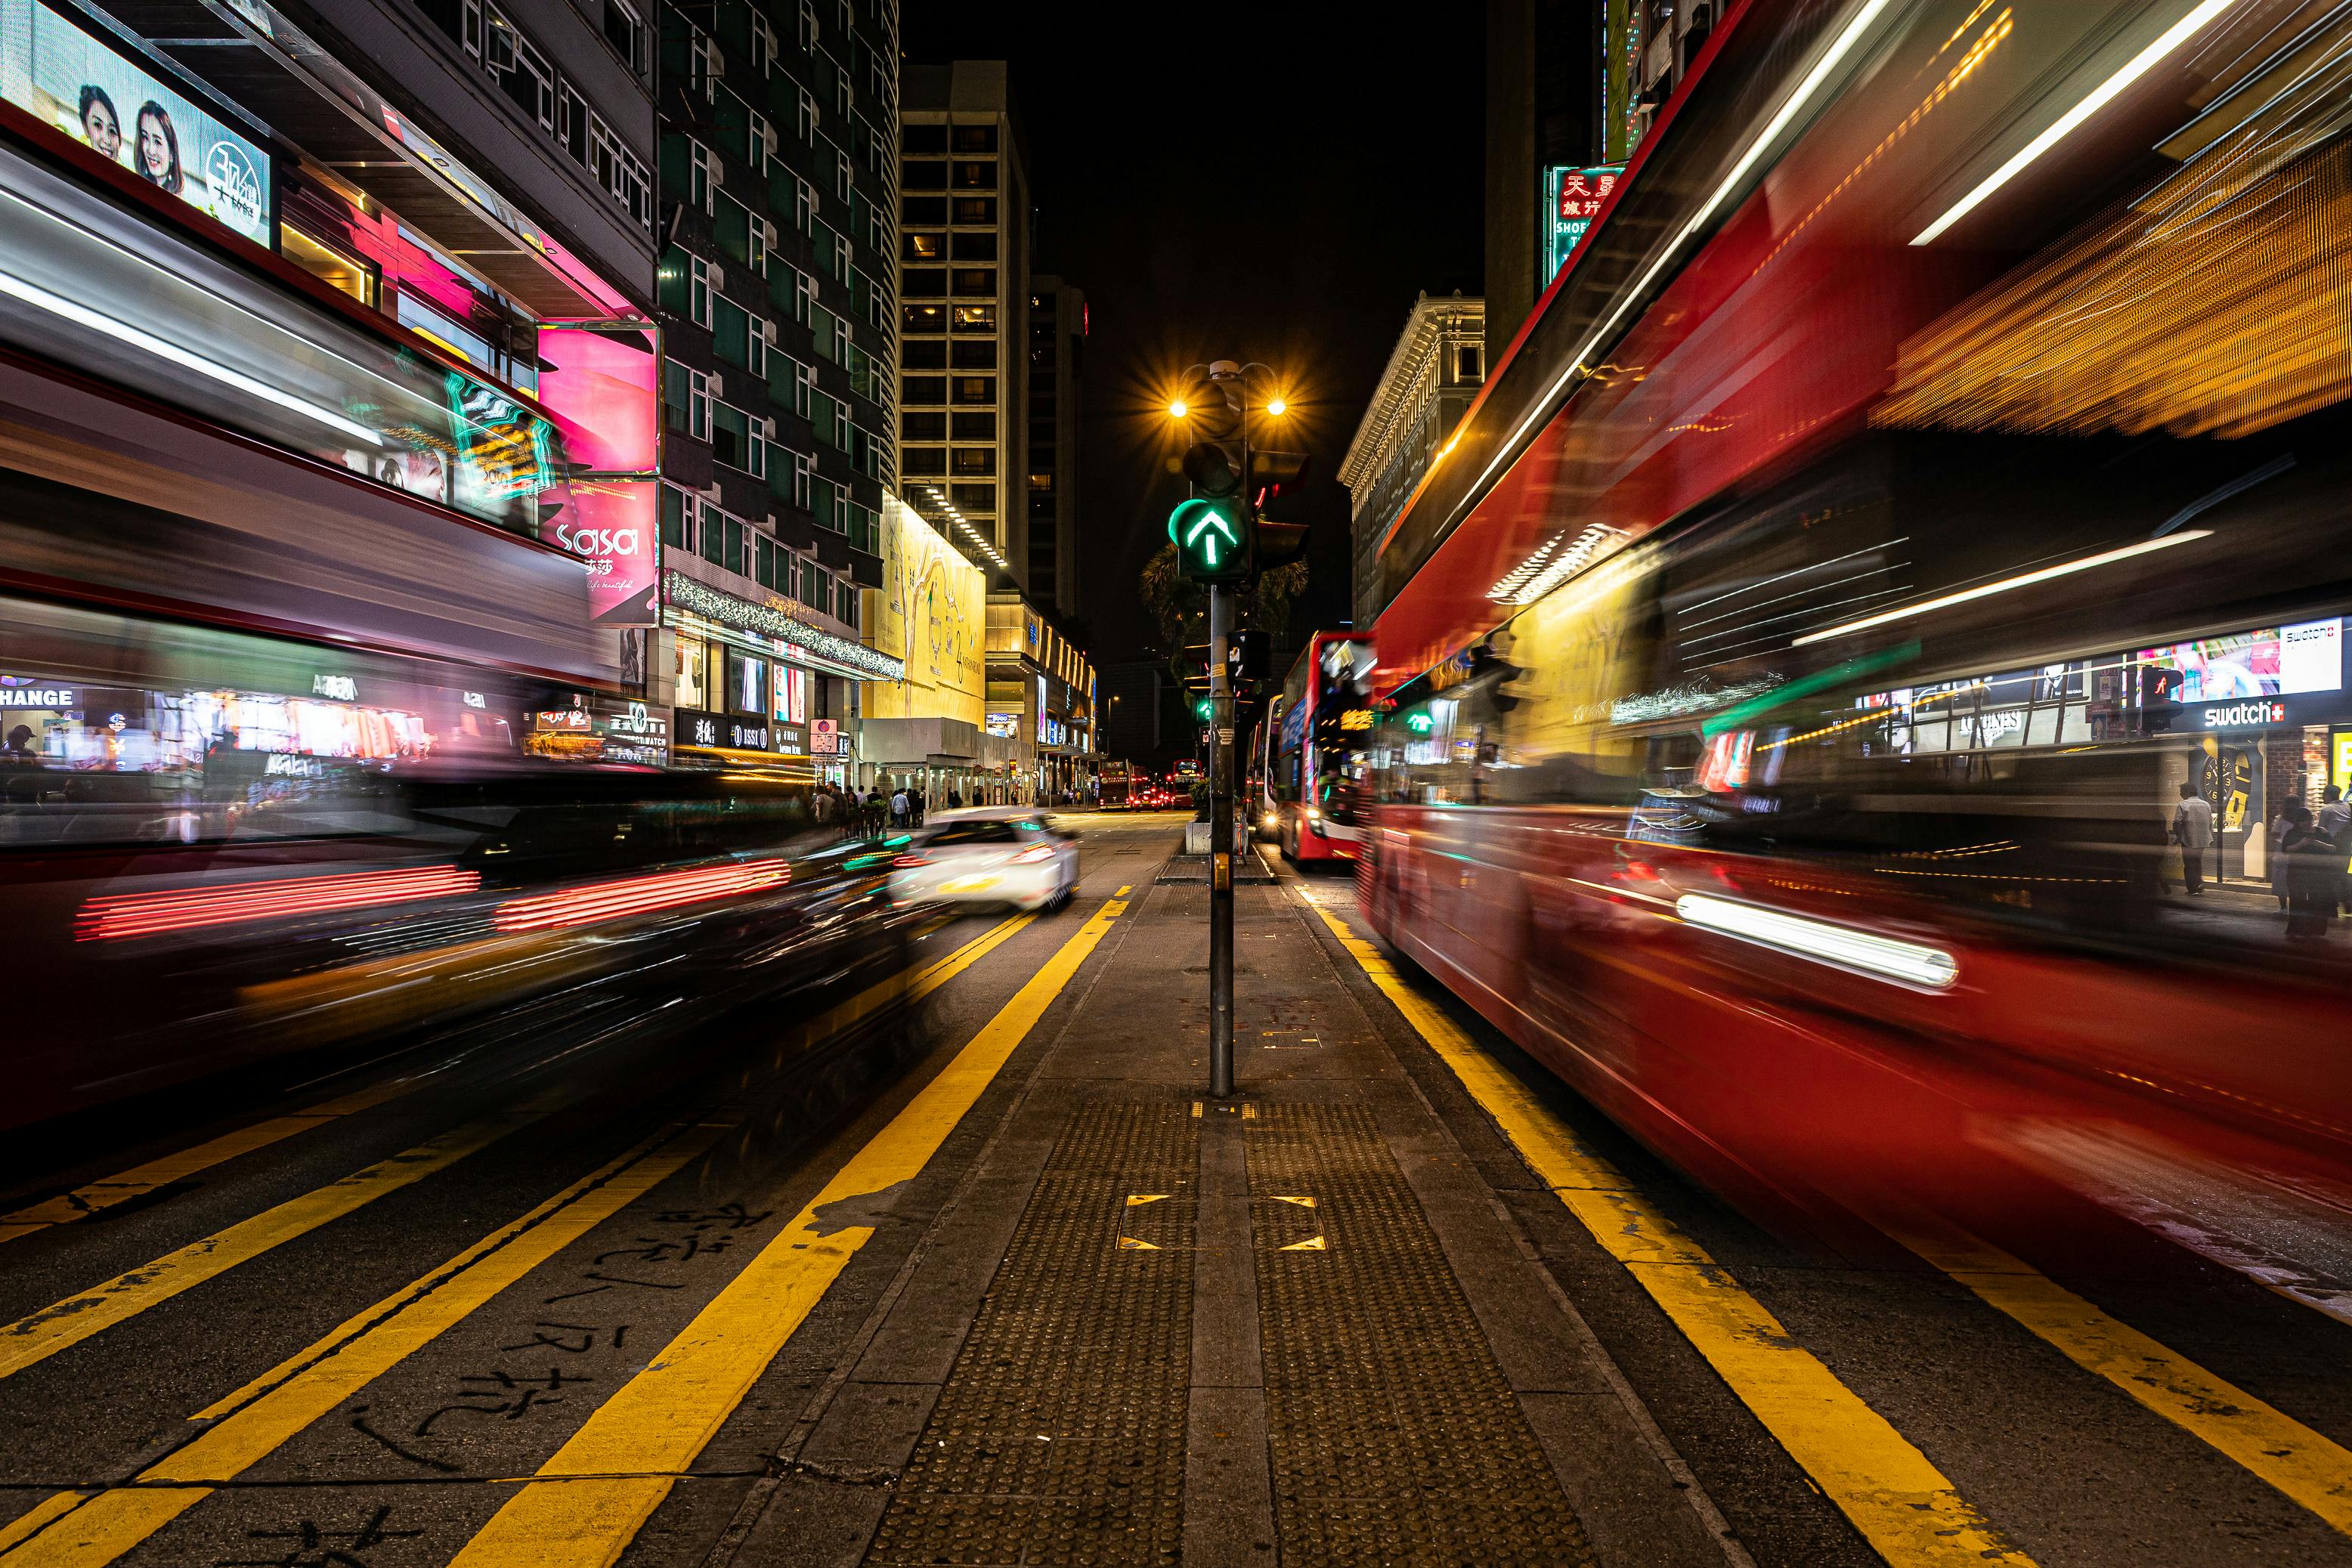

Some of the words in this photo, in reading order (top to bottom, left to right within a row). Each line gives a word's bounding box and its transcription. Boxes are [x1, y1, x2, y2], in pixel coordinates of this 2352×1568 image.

[1564, 175, 1614, 196] 天星
[1563, 201, 1601, 215] 旅行
[1556, 222, 1591, 233] SHOE
[602, 580, 633, 592] beautiful
[2286, 628, 2326, 642] swatch
[2205, 701, 2271, 727] swatch
[744, 728, 758, 745] ISSI
[2212, 791, 2217, 799] 6
